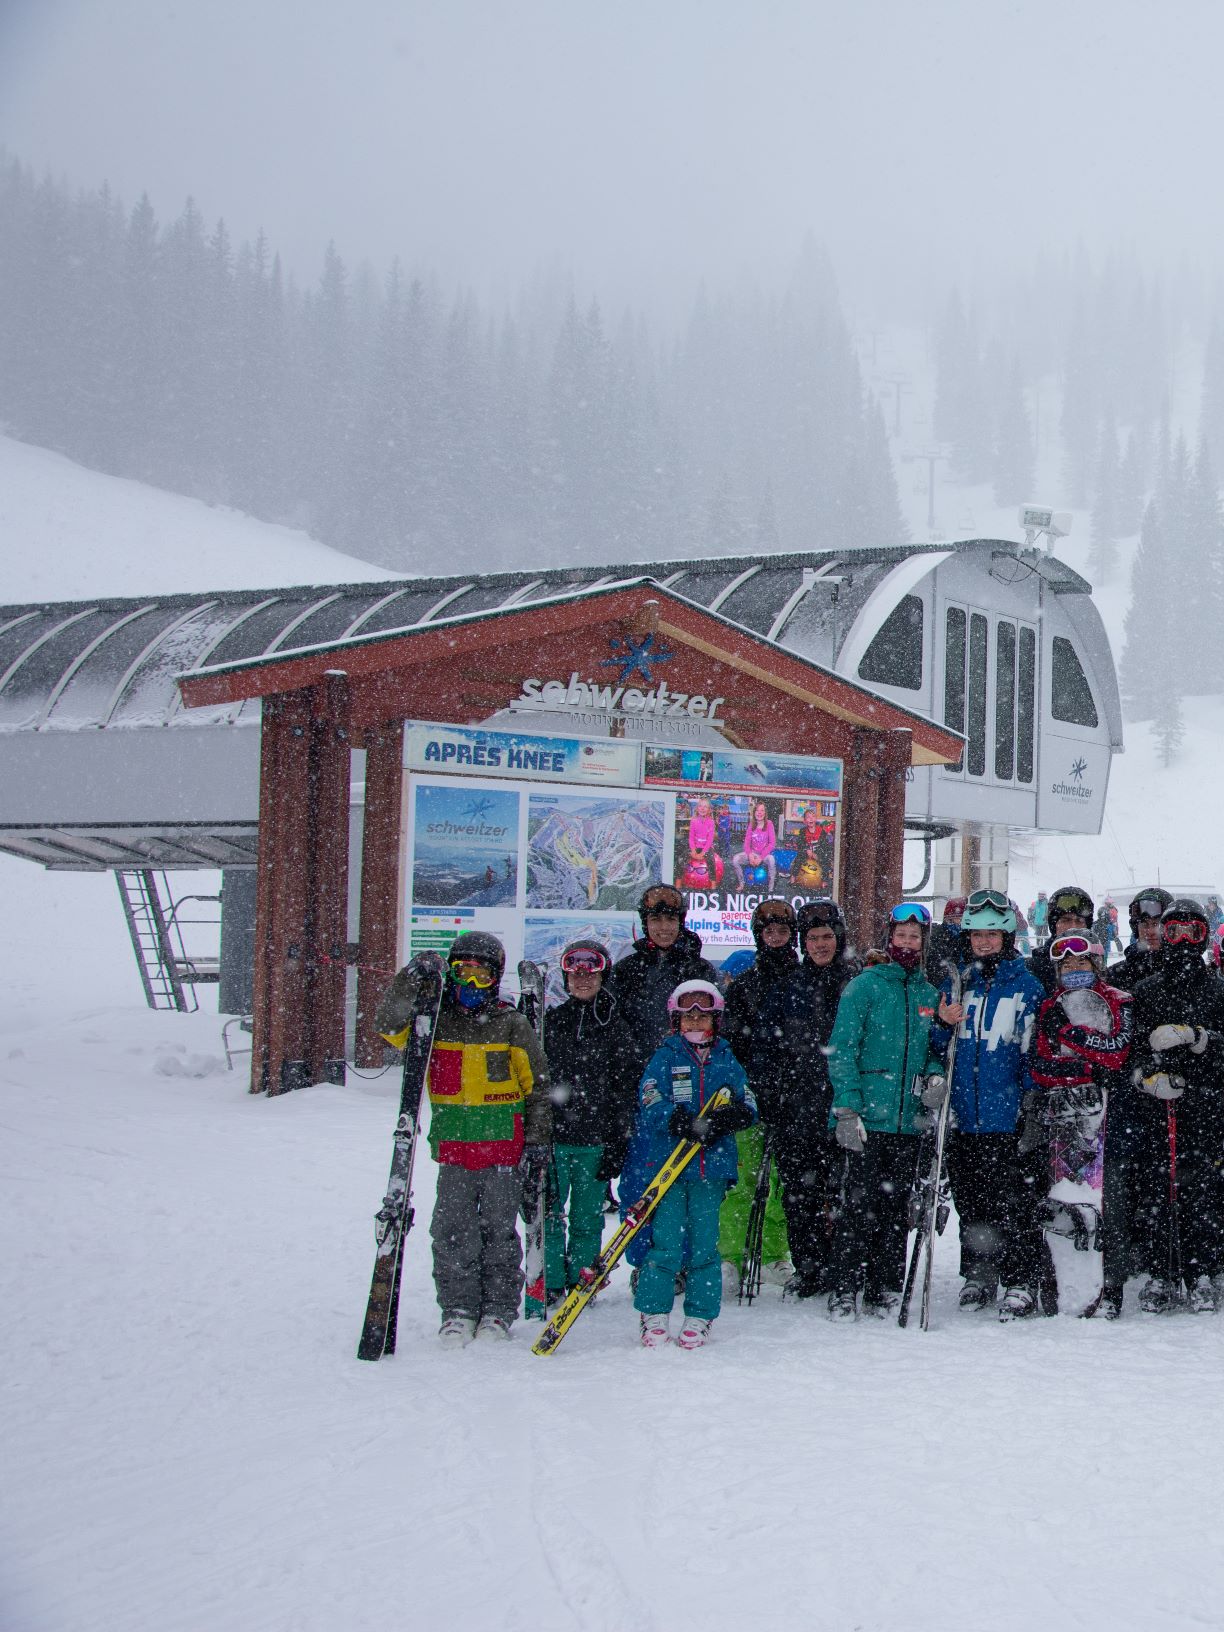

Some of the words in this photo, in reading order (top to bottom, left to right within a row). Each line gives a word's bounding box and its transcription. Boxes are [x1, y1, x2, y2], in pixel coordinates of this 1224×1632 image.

[519, 672, 725, 720] schweitzer
[425, 740, 501, 767] APRÉS
[508, 748, 566, 773] KNEE
[1051, 780, 1093, 798] schweitzer
[426, 820, 508, 837] schweitzer
[680, 892, 720, 911] IDS
[726, 893, 785, 912] NIG
[721, 912, 752, 921] parents
[684, 919, 720, 932] elping
[723, 920, 748, 931] kids
[710, 934, 723, 942] the
[725, 934, 752, 944] Activity
